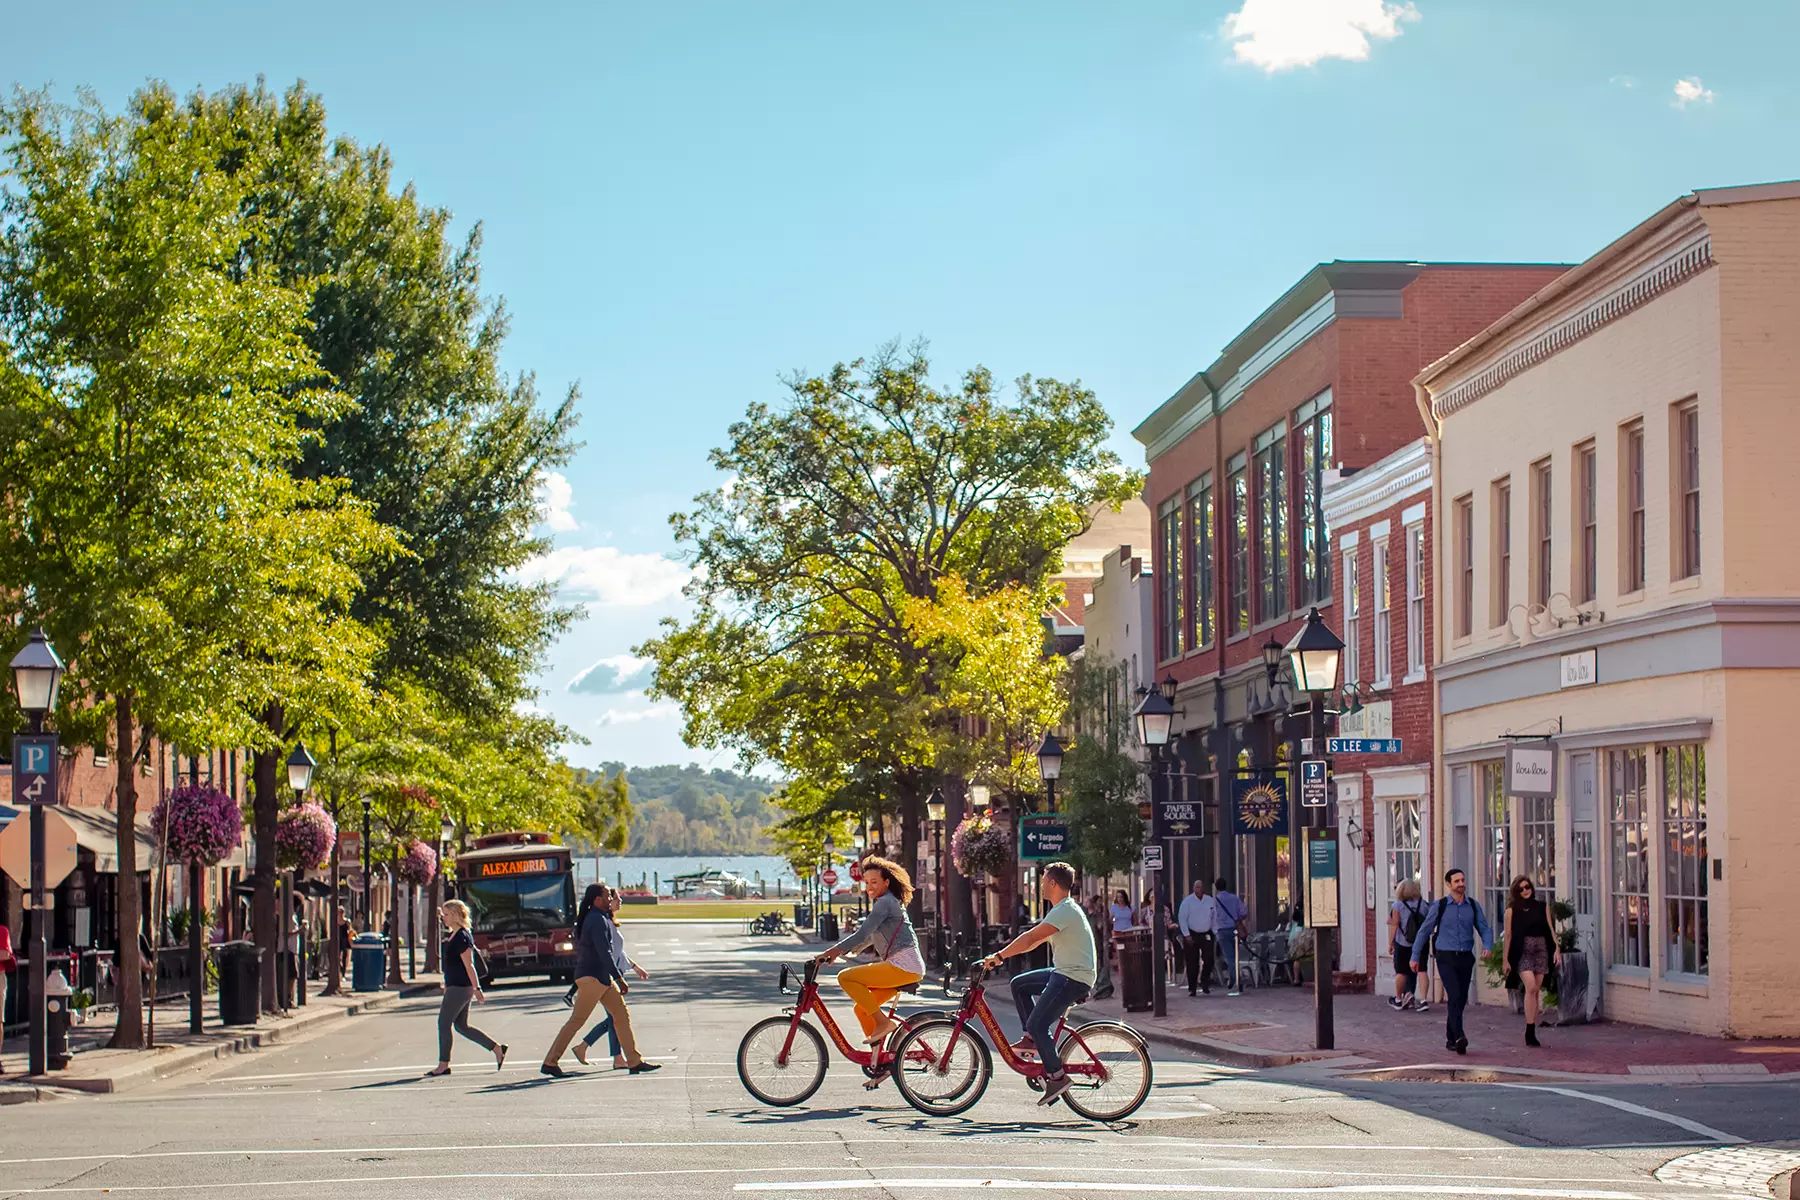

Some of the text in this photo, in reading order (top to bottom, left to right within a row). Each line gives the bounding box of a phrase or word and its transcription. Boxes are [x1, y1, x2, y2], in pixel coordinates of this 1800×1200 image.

[1331, 740, 1362, 752] S LEE
[25, 747, 44, 772] P
[1310, 764, 1318, 778] P
[1515, 761, 1549, 776] lou lou
[1165, 804, 1193, 813] PAPER
[1163, 812, 1197, 821] SOURCE
[1039, 833, 1064, 842] Torpedo
[1038, 842, 1062, 852] Factory
[482, 859, 547, 876] ALEXANDRIA
